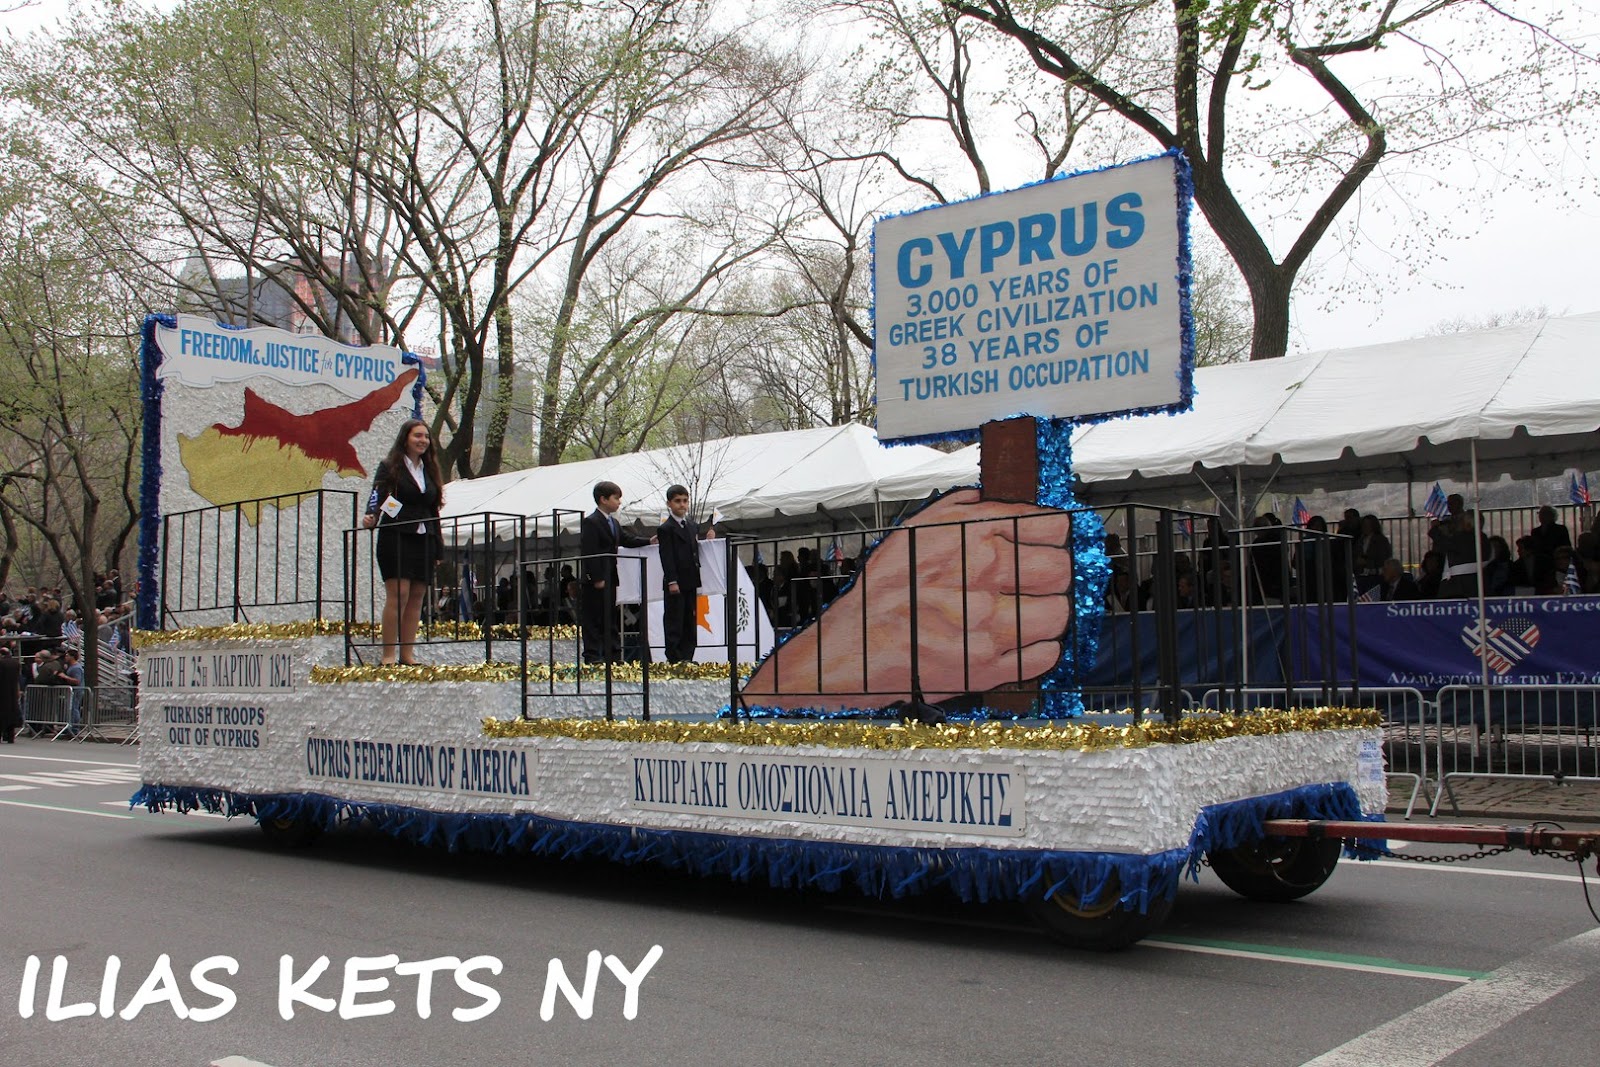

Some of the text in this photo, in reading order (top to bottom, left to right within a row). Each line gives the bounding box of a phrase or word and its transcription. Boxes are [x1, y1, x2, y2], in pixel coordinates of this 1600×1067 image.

[897, 192, 1145, 288] CYPRUS
[990, 268, 1070, 302] YEARS
[1084, 259, 1118, 288] OF
[889, 282, 1158, 346] GREEK CIVILIZATION
[181, 329, 396, 384] FREEDOM & JUSTICE for CYPRUS
[922, 320, 1109, 369] 38 YEARS OF
[900, 349, 1149, 401] TURKISH OCCUPATION
[1386, 602, 1480, 618] Solidarity
[1489, 599, 1534, 614] with
[147, 656, 174, 688] ΖΗΤΩ
[178, 656, 186, 687] Η
[212, 654, 263, 687] ΜΑΡΤΙΟΥ
[269, 653, 293, 687] 1821
[1519, 674, 1550, 685] την
[164, 706, 265, 726] TURKISH TROOPS
[169, 727, 260, 748] OUT OF CYPRUS
[306, 736, 530, 796] CYPRUS FEDERATION OF AMERICA
[633, 757, 1012, 827] ΚΥΠΡΙΑΚΗ ΟΜΟΣΠΟΝΔΙΑ ΑΜΕΡΙΚΗΣ
